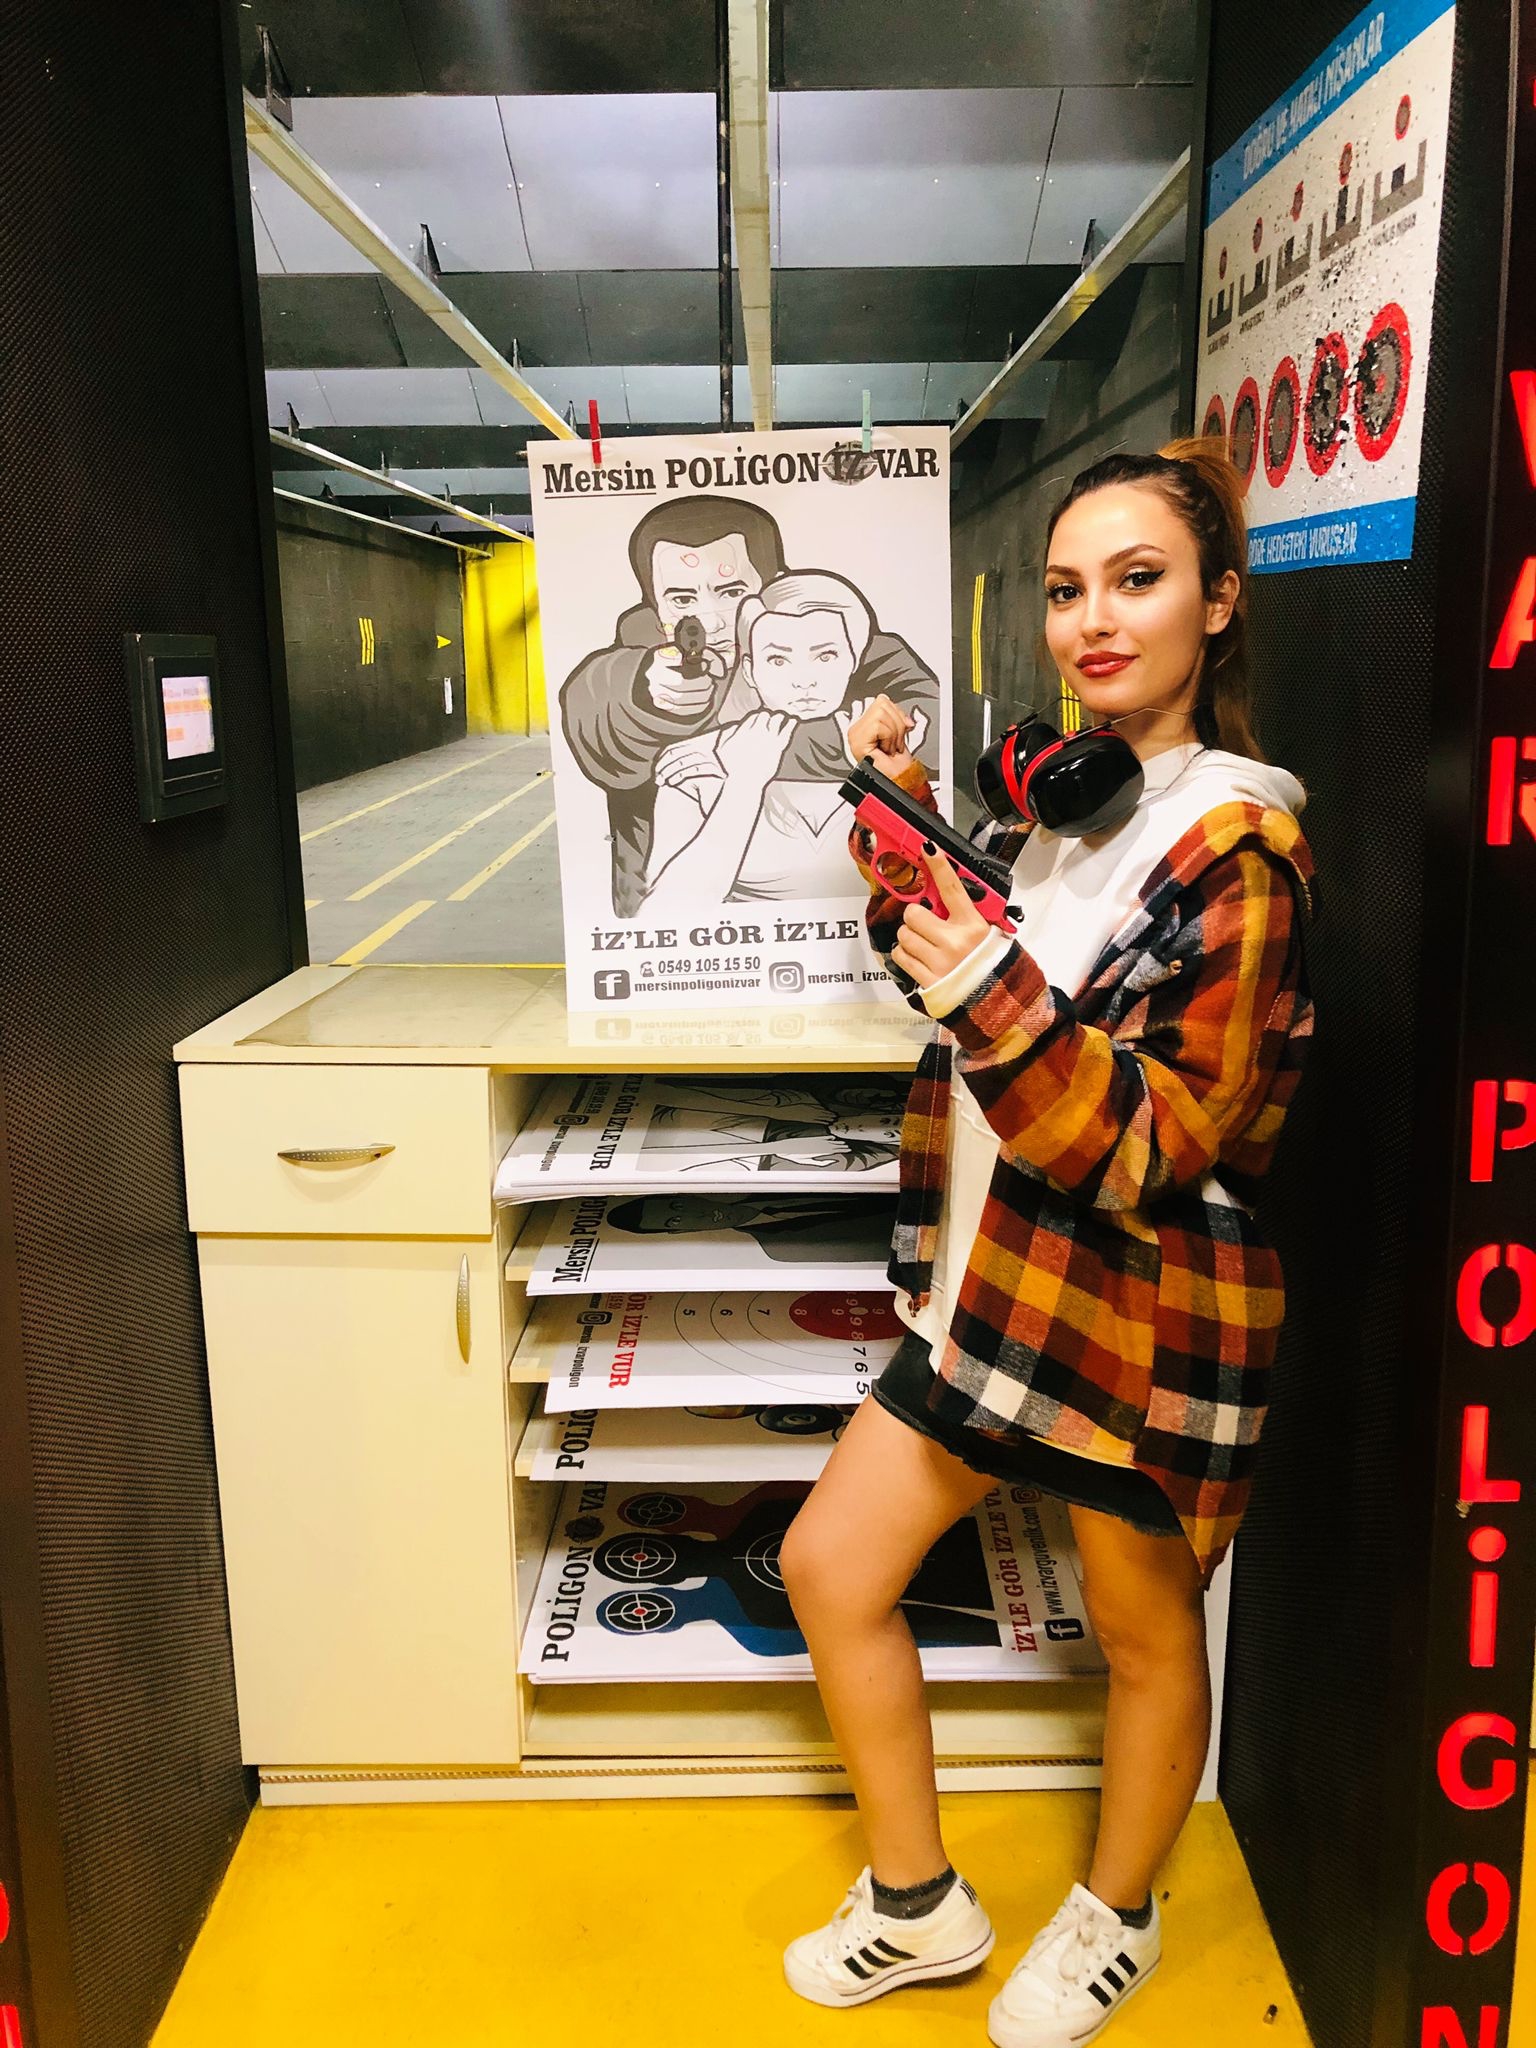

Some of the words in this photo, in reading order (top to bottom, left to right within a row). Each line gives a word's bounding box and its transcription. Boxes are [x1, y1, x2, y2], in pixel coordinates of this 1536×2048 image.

[1276, 108, 1289, 151] VE
[543, 461, 657, 493] Mersin
[665, 446, 821, 489] POLİGON
[874, 448, 941, 478] VAR
[591, 926, 678, 951] İZ'LE
[689, 920, 764, 947] GÖR
[774, 917, 859, 942] İZ'LE
[658, 959, 692, 974] 0549
[695, 957, 720, 972] 105
[724, 956, 741, 971] 15
[744, 955, 761, 970] 50
[807, 970, 892, 985] mersin_izva
[634, 977, 761, 992] mersinpoligonizvar
[589, 1143, 618, 1171] VUR
[552, 1239, 594, 1283] Mersin
[682, 1308, 696, 1317] 5
[720, 1308, 733, 1317] 6
[757, 1308, 770, 1316] 7
[794, 1307, 808, 1317] 8
[617, 1314, 648, 1348] İZ'LE
[850, 1331, 865, 1342] 8
[852, 1346, 867, 1357] 7
[608, 1352, 635, 1389] VUR
[854, 1361, 869, 1373] 6
[856, 1381, 870, 1396] 5
[555, 1409, 599, 1470] POLİG
[986, 1511, 1015, 1555] İZ'LE
[994, 1557, 1025, 1598] GÖR
[541, 1545, 595, 1663] POLİGON
[1007, 1602, 1039, 1653] İZ'LE
